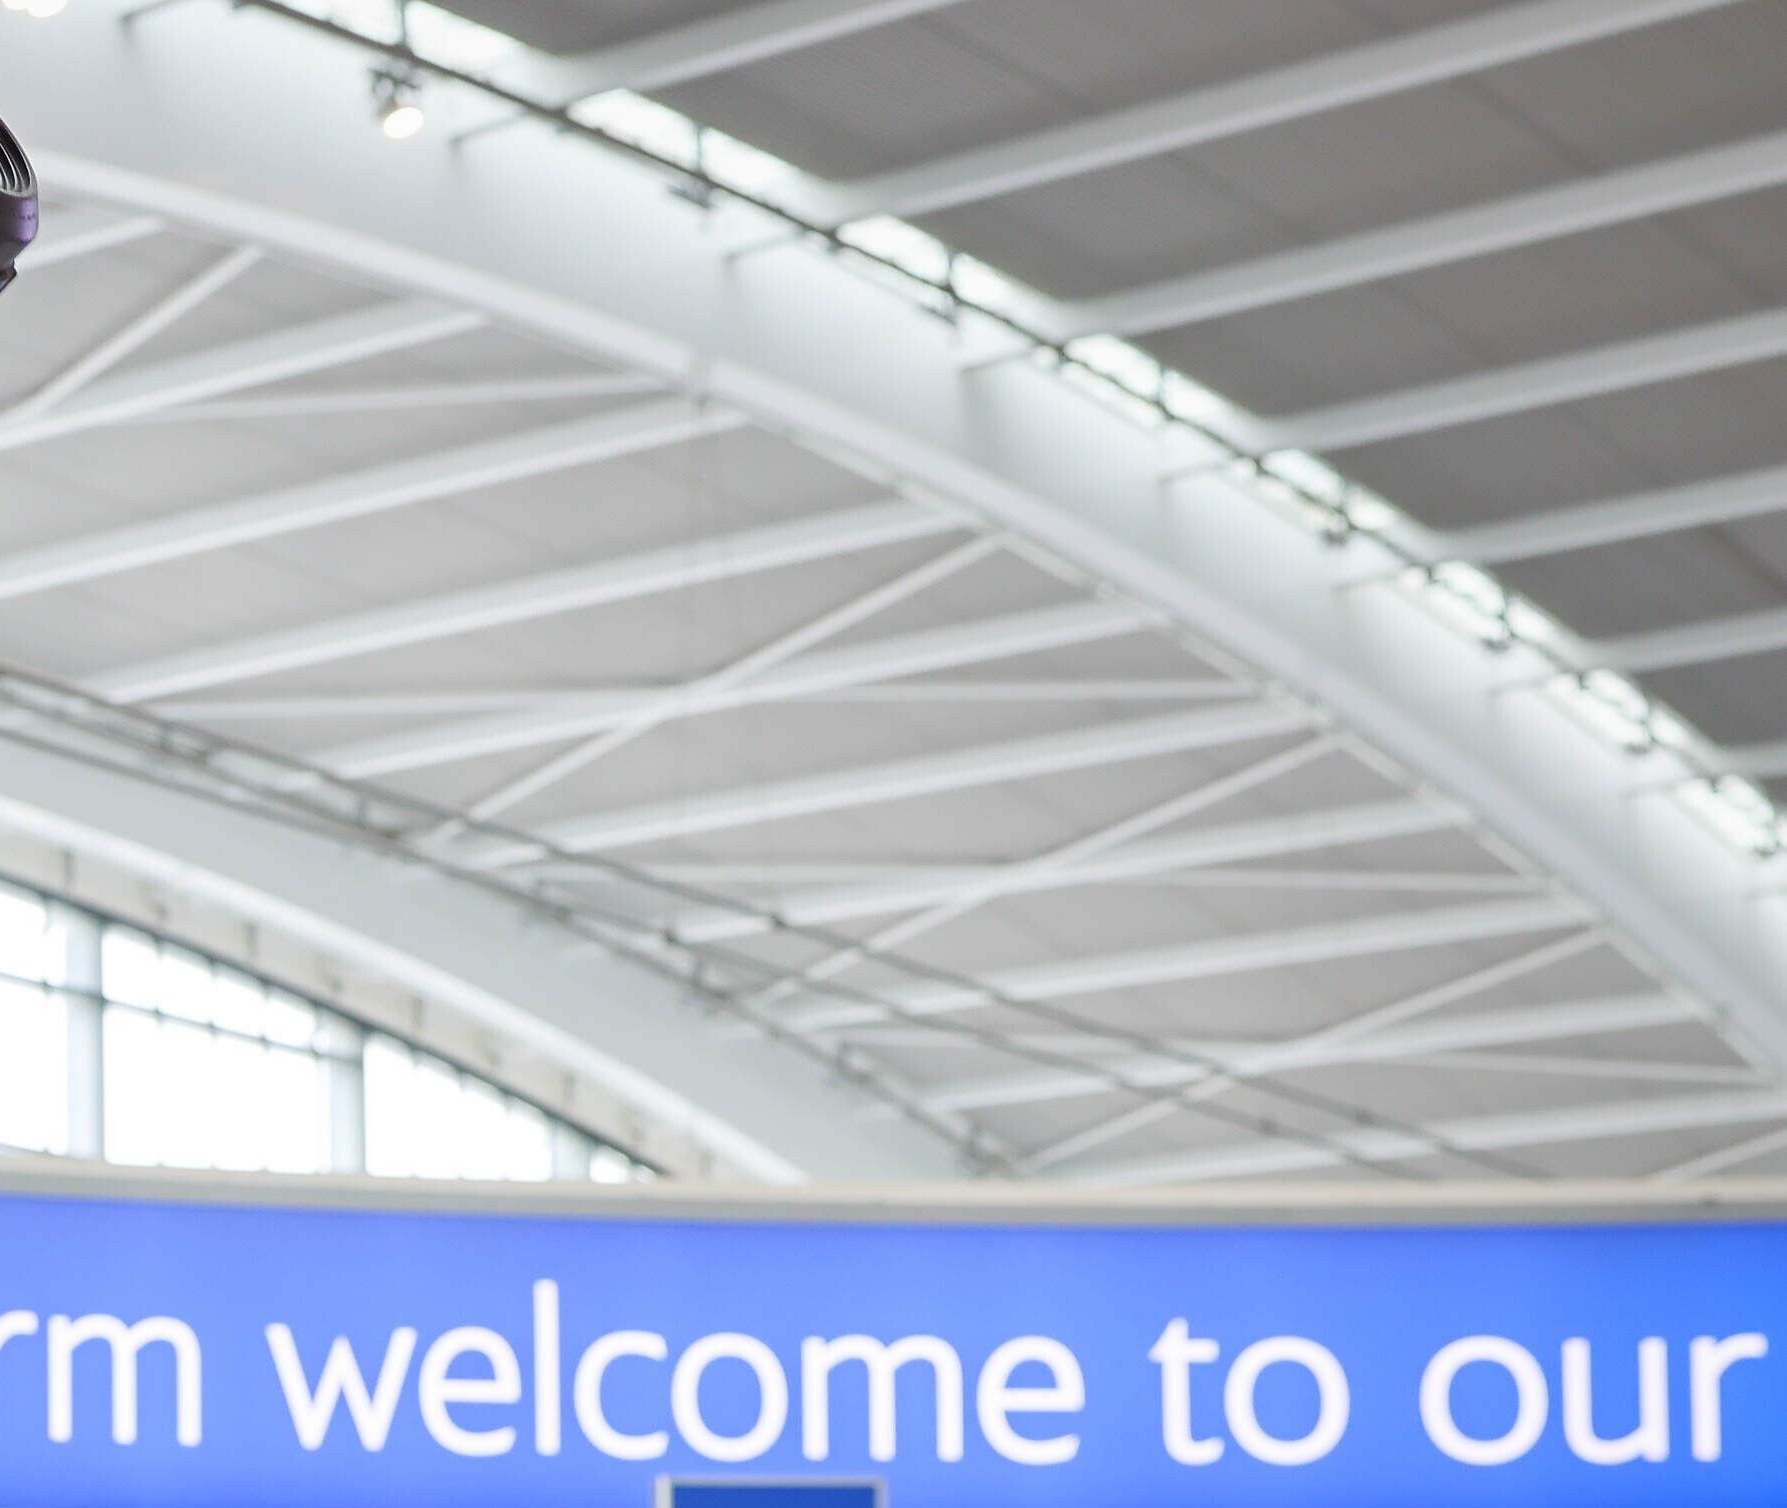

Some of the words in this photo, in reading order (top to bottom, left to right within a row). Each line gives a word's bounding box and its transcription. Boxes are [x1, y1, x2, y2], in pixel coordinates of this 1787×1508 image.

[264, 1278, 1086, 1466] welcome
[1149, 1318, 1351, 1466] to
[1419, 1333, 1767, 1466] our
